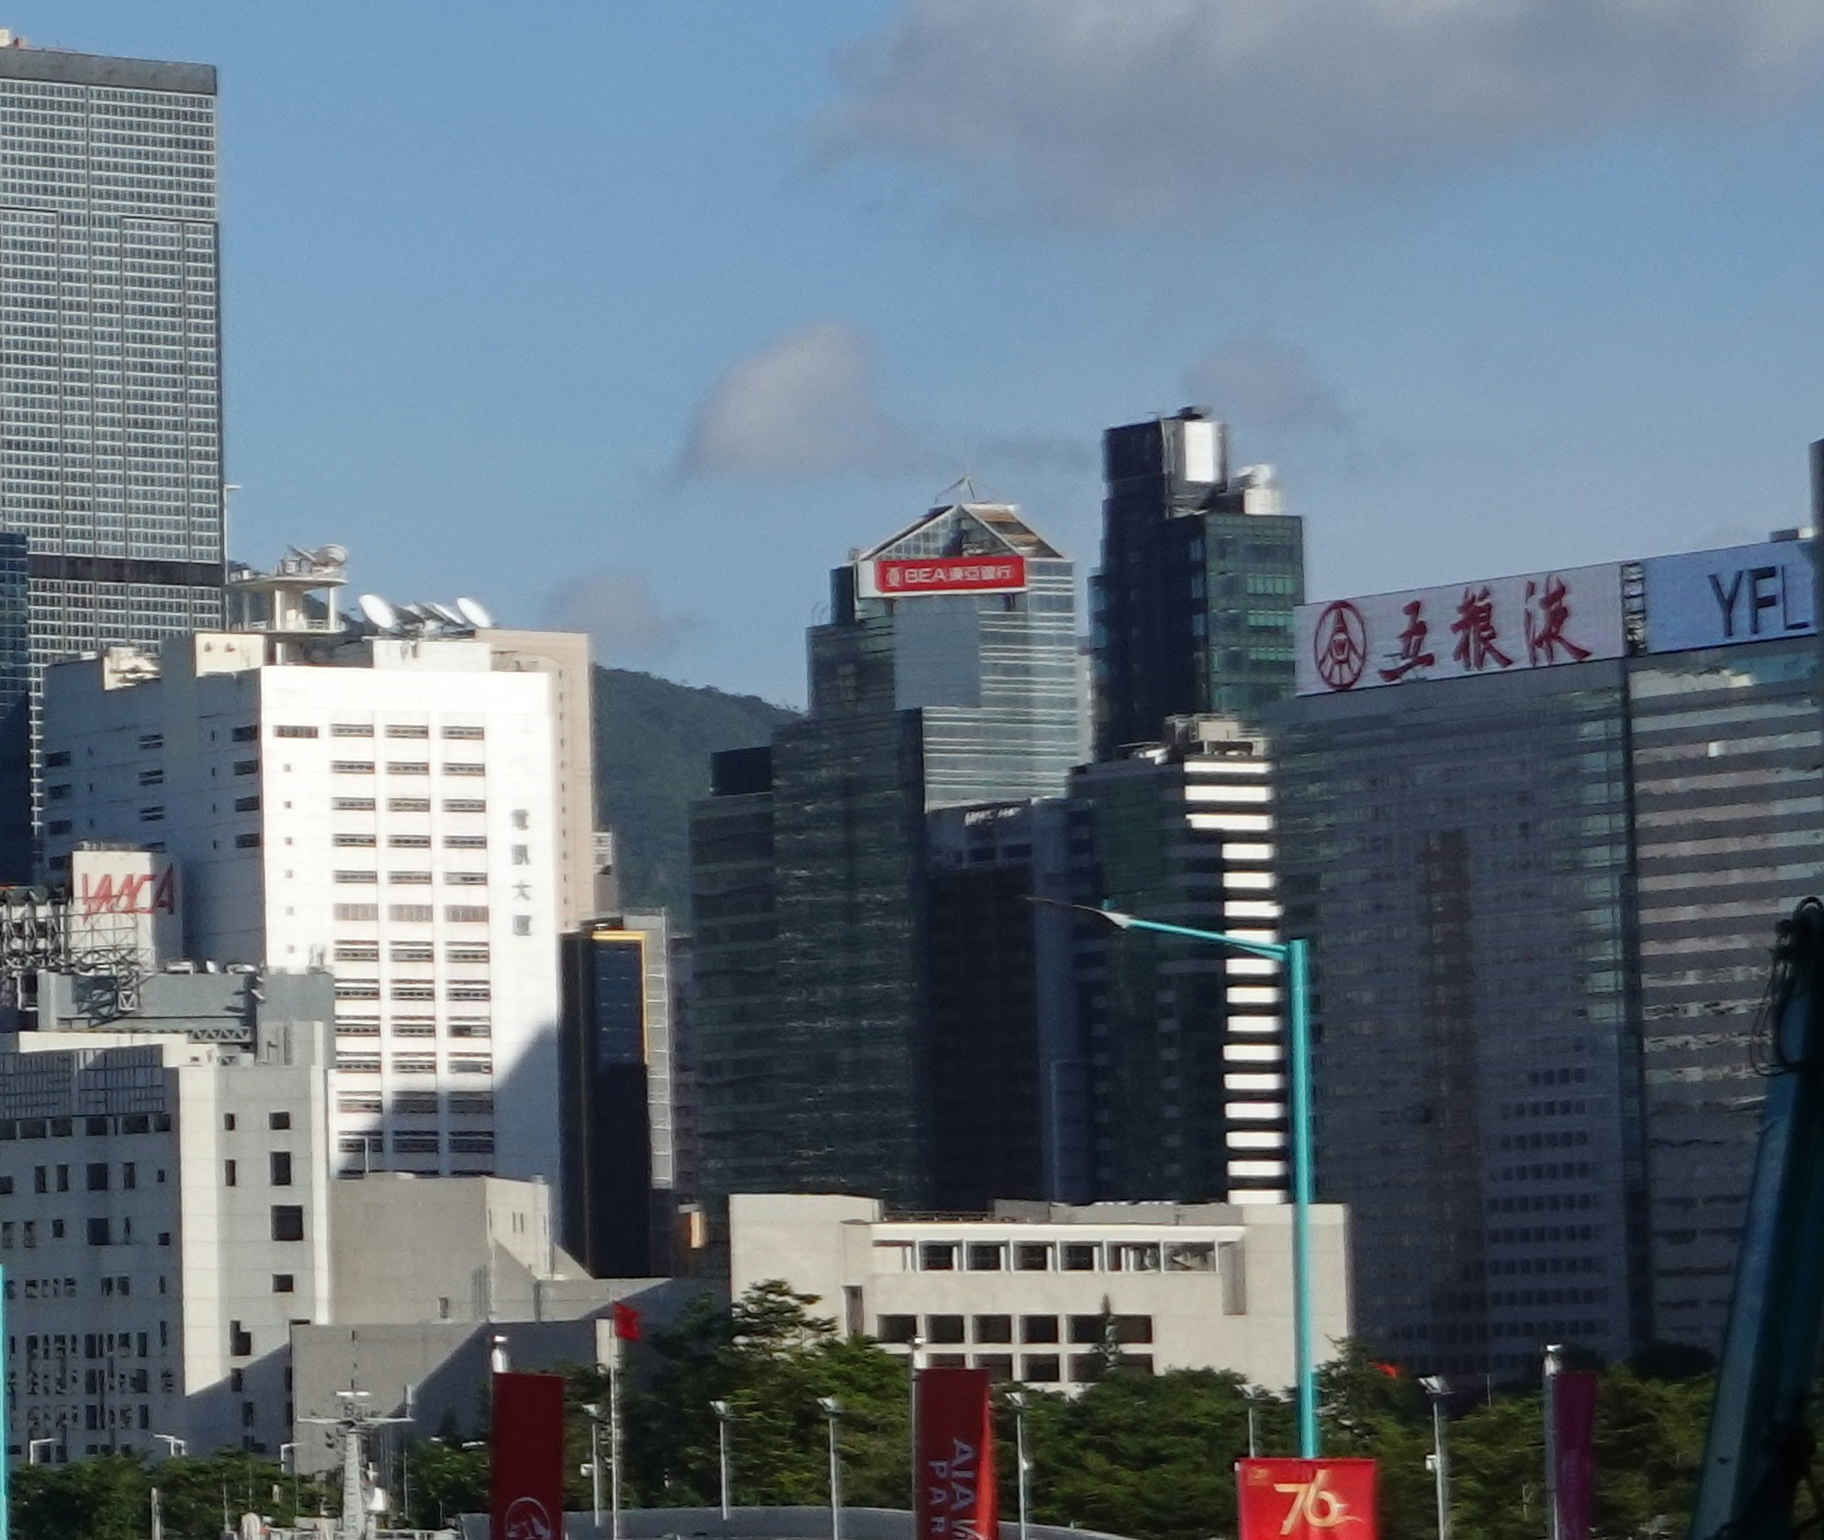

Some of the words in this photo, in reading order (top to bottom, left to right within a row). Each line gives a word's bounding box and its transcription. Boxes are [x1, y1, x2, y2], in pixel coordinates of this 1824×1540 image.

[904, 567, 946, 583] BEA
[1377, 574, 1593, 682] 五粮液
[952, 1437, 976, 1510] AIA
[1273, 1469, 1340, 1535] 76
